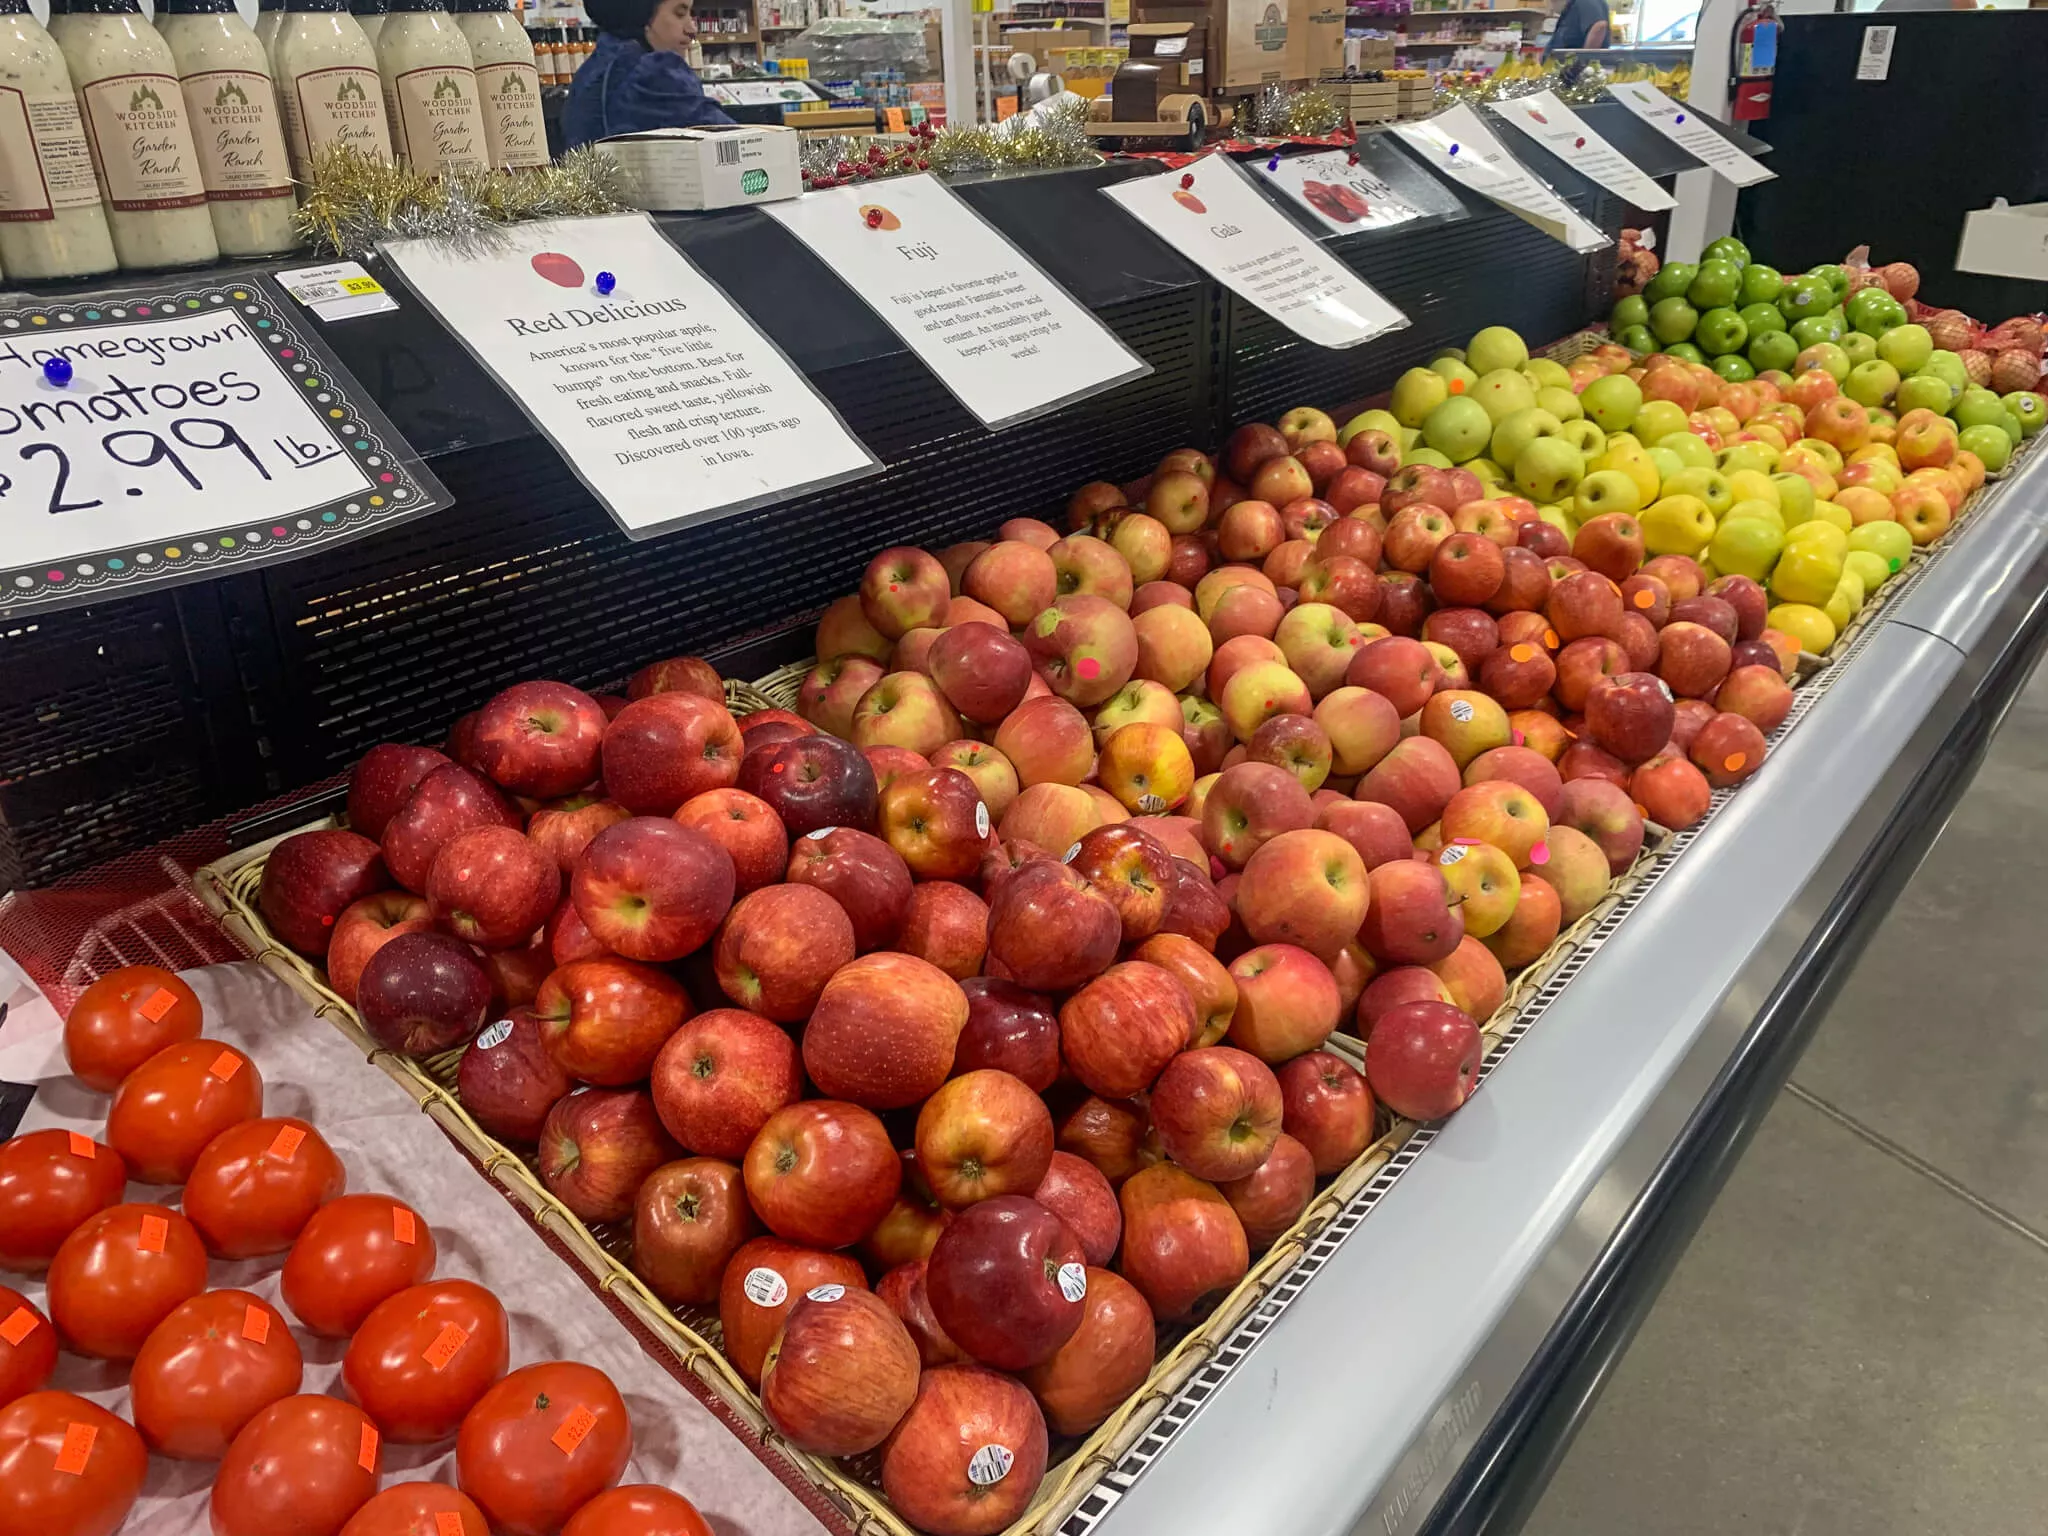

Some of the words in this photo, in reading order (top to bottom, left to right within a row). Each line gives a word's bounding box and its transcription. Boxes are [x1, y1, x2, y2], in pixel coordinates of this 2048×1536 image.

[324, 101, 378, 110] WOODSIDE
[422, 97, 472, 108] WOODSIDE
[490, 93, 536, 102] WOODSIDE
[496, 101, 535, 110] KITCHEN
[116, 110, 178, 120] WOODSIDE
[202, 105, 264, 115] WOODSIDE
[210, 115, 262, 125] KITCHEN
[332, 110, 376, 120] KITCHEN
[428, 108, 471, 116] KITCHEN
[124, 120, 176, 131] KITCHEN
[337, 124, 376, 144] Garden
[433, 121, 470, 142] Garden
[500, 114, 534, 134] Garden
[132, 136, 176, 160] Garden
[216, 130, 260, 152] Garden
[438, 139, 472, 156] Ranch
[504, 132, 535, 148] Ranch
[139, 156, 181, 176] Ranch
[222, 150, 263, 168] Ranch
[1210, 224, 1243, 239] Gala
[896, 241, 939, 261] Fuji
[347, 281, 378, 291] $3.99
[890, 292, 912, 304] Fuji
[984, 273, 1007, 285] apple
[914, 304, 937, 318] good
[965, 290, 1004, 304] Fantastic
[504, 312, 568, 336] Red
[564, 298, 687, 328] Delicious
[924, 320, 942, 332] and
[984, 305, 1004, 314] with
[977, 326, 992, 334] An
[1032, 307, 1052, 322] good
[529, 342, 598, 362] America's
[600, 336, 631, 350] most
[632, 328, 678, 346] popular
[680, 322, 717, 338] apple,
[991, 335, 1010, 348] Fuji
[1028, 324, 1050, 338] crisp
[560, 360, 608, 374] known
[608, 354, 630, 367] for
[630, 350, 652, 362] the
[651, 344, 684, 357] "five
[683, 340, 713, 352] little
[553, 375, 605, 394] bumps"
[609, 372, 628, 384] on
[627, 366, 650, 380] the
[648, 360, 698, 377] bottom.
[698, 354, 726, 368] Best
[726, 350, 746, 362] for
[576, 394, 612, 410] fresh
[613, 386, 656, 403] eating
[654, 381, 680, 394] and
[680, 374, 726, 390] snacks.
[722, 368, 753, 382] Full-
[586, 408, 644, 429] flavored
[644, 402, 682, 416] sweet
[682, 395, 718, 408] taste,
[716, 382, 774, 404] yellowish
[626, 424, 663, 440] flesh
[662, 418, 688, 434] and
[688, 414, 719, 428] crisp
[718, 405, 766, 421] texture.
[274, 435, 334, 465] lb.
[615, 438, 692, 465] Discovered
[692, 432, 721, 448] over
[720, 426, 746, 442] 100
[746, 420, 781, 438] years
[780, 416, 801, 430] ago
[700, 454, 718, 466] in
[716, 448, 754, 462] Iowa.
